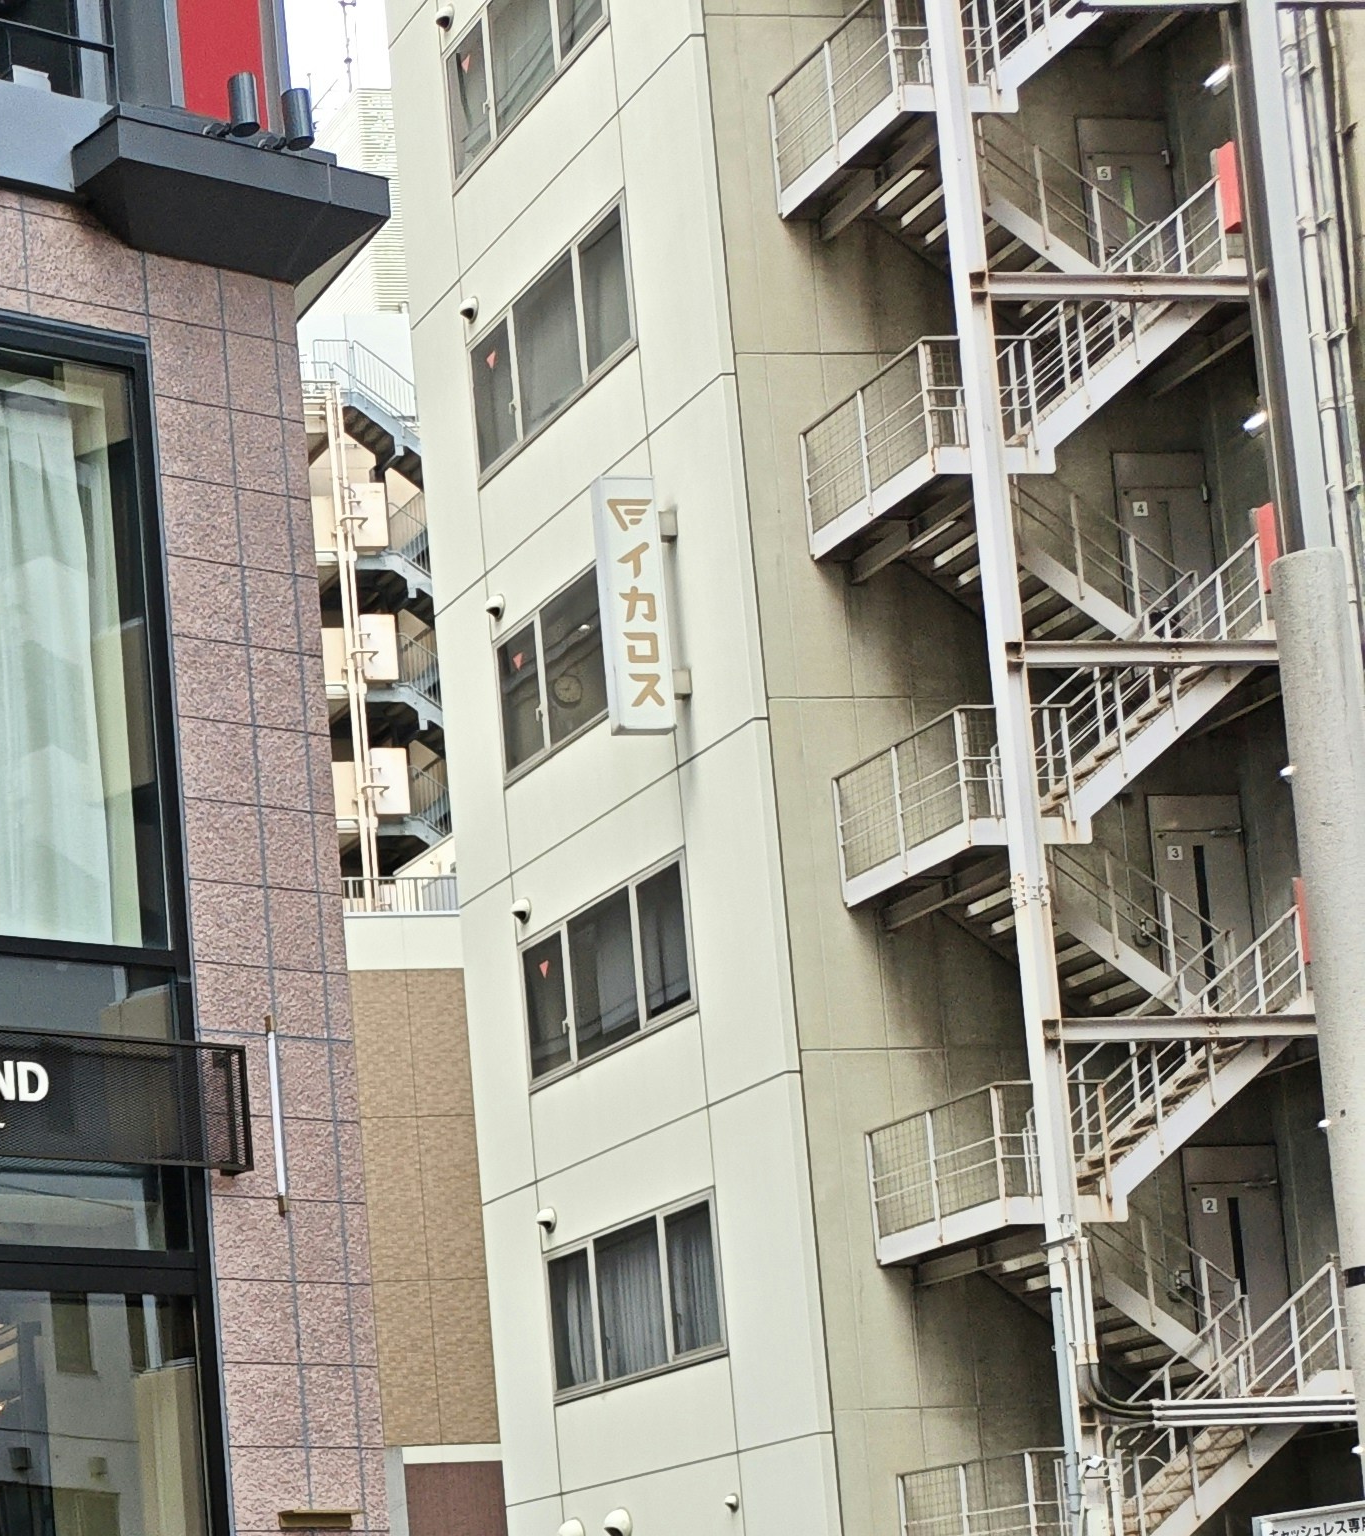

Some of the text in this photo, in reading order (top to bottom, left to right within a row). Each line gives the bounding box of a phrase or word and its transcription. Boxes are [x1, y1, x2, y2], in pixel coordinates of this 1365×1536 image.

[1136, 503, 1145, 514] 4
[1171, 847, 1180, 859] 3
[1206, 1199, 1214, 1211] 2
